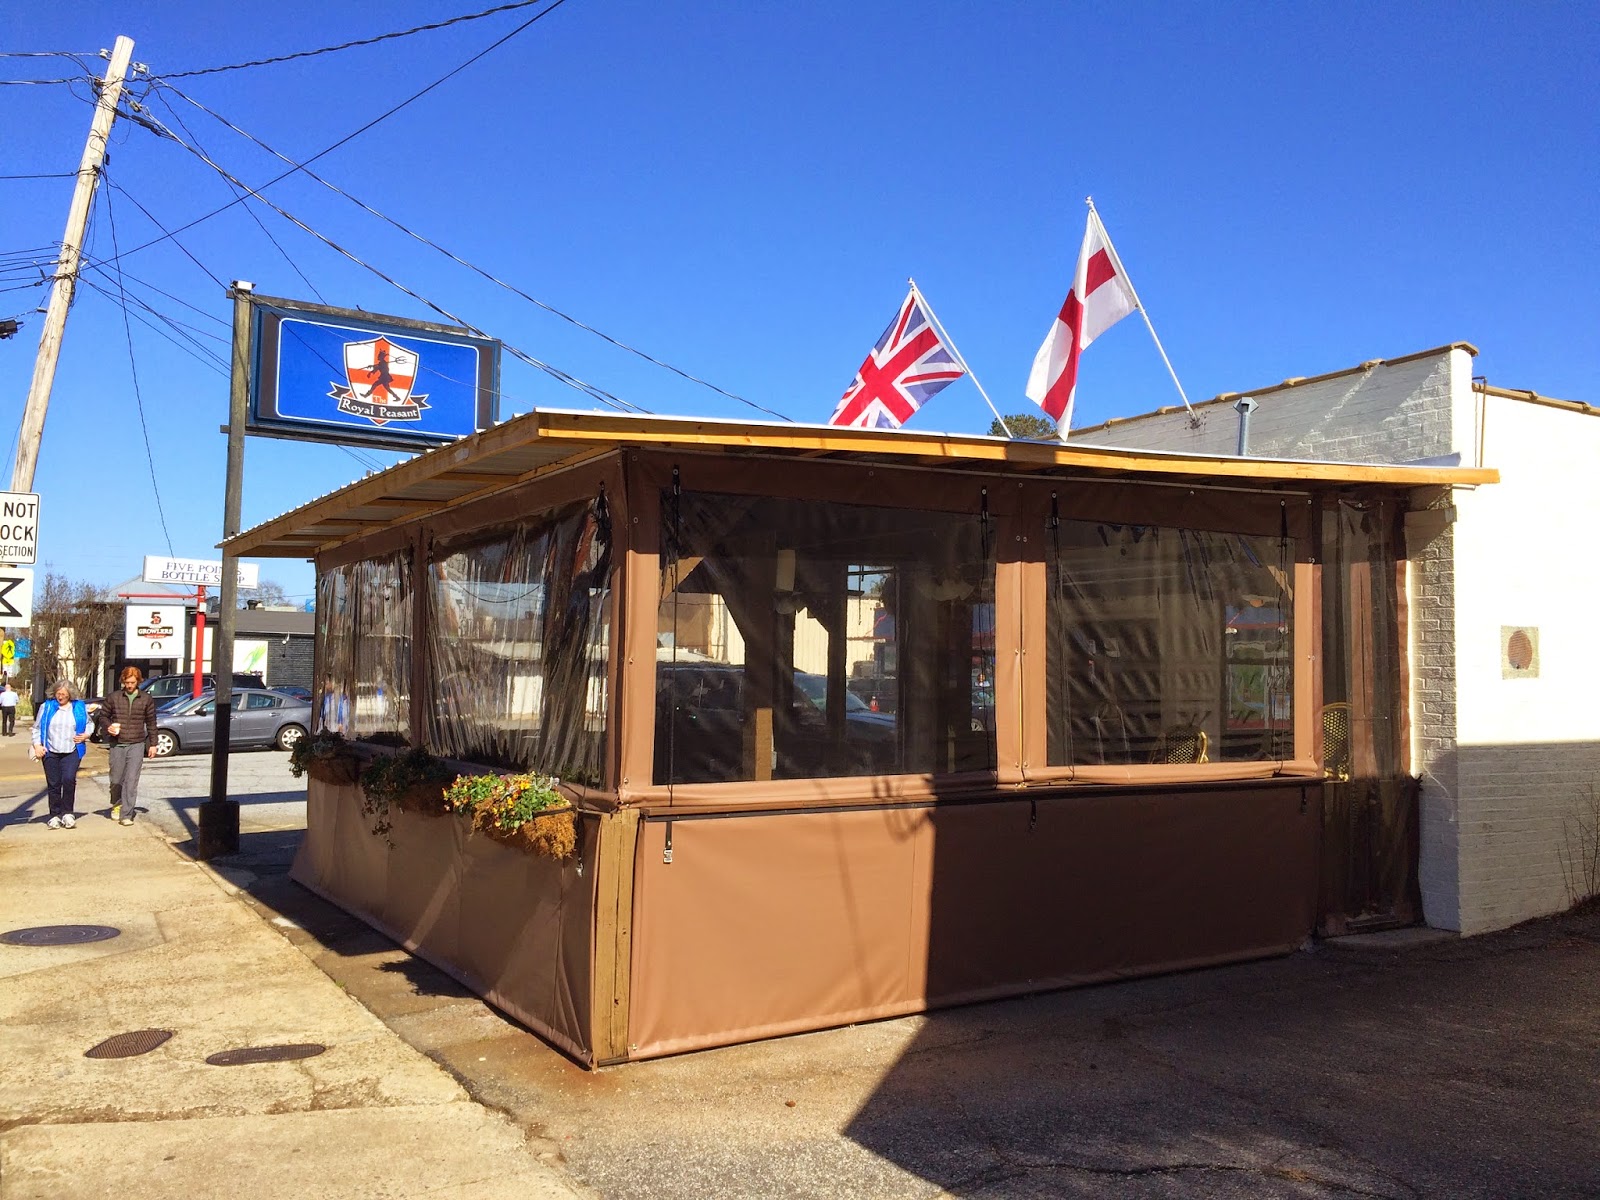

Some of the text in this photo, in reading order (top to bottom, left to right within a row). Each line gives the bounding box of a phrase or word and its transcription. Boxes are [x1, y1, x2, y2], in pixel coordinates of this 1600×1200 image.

[374, 395, 387, 404] The
[341, 398, 418, 418] Royal Peasant
[3, 501, 37, 519] NOT
[0, 524, 34, 541] OCK
[166, 561, 243, 576] FIVE POIS
[161, 570, 245, 584] BOTTLE SP
[150, 611, 162, 625] 5
